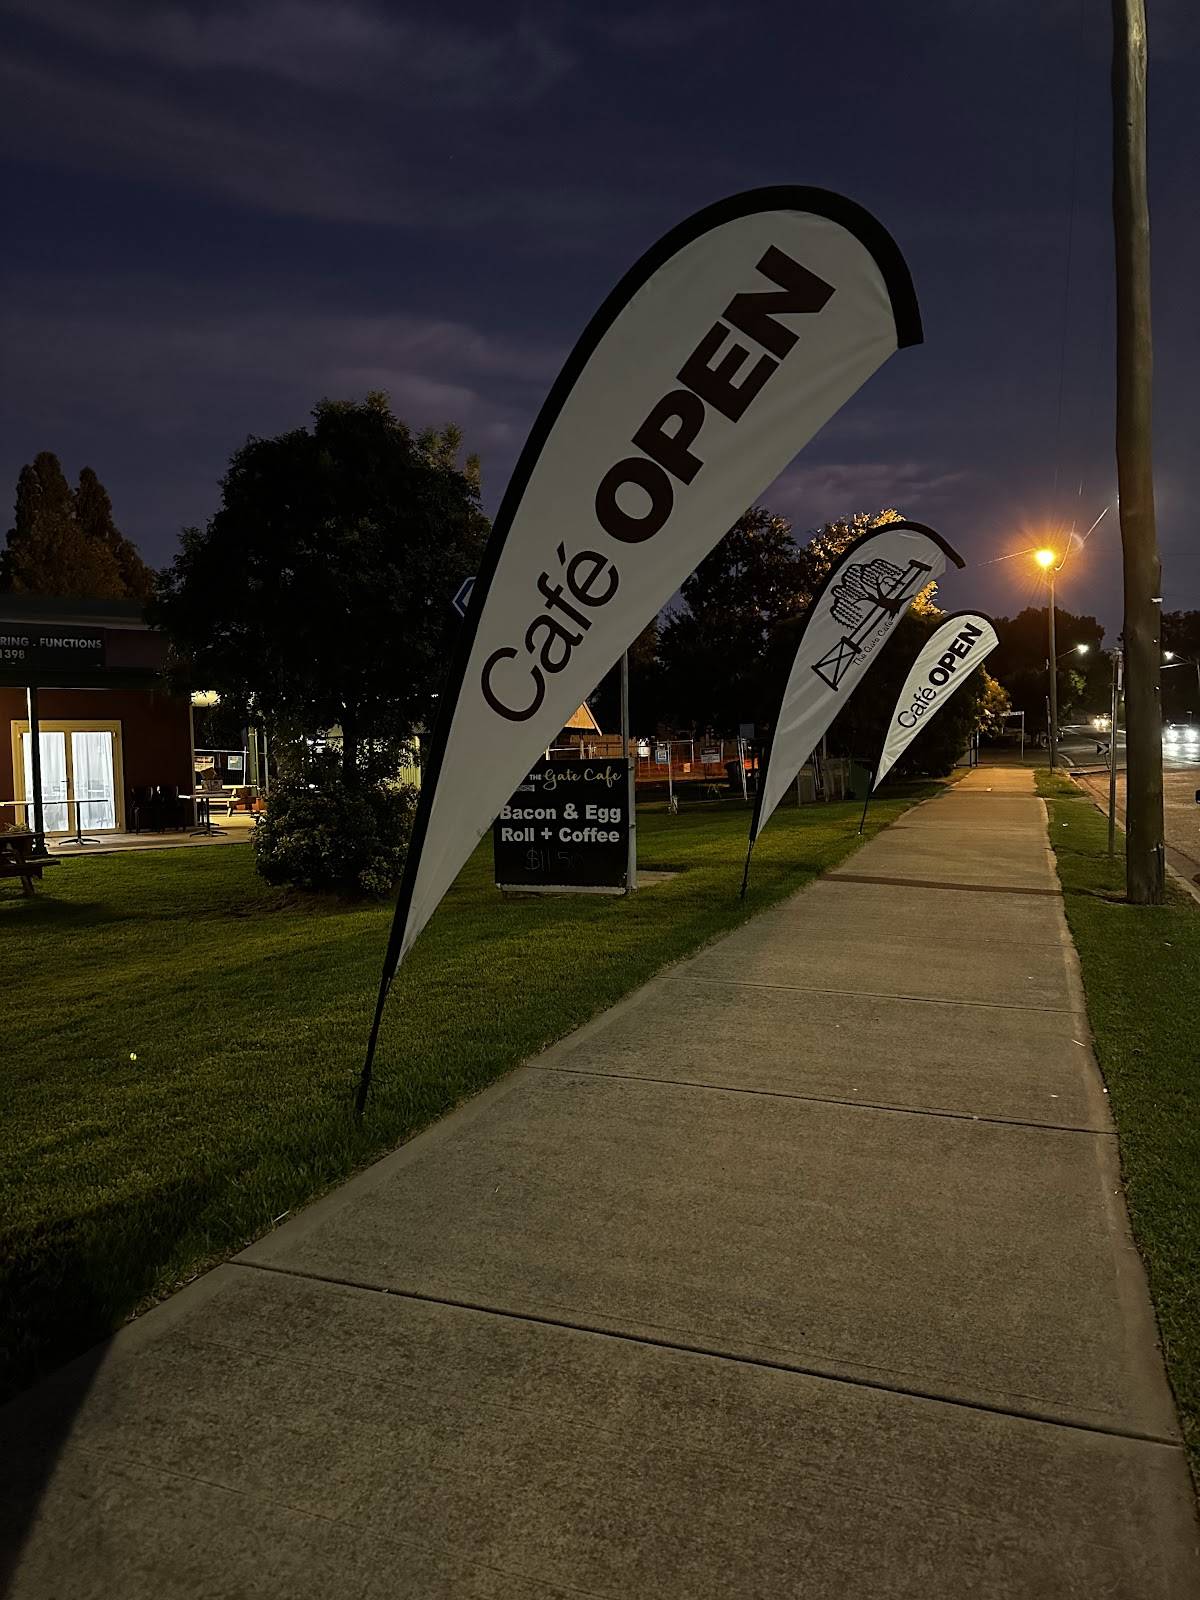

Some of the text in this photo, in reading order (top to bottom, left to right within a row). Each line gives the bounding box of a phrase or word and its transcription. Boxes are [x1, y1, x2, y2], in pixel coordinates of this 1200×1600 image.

[481, 245, 835, 721] Café OPEN
[0, 636, 30, 647] RING
[40, 637, 102, 649] FUNCTIONS
[898, 623, 983, 728] Café OPEN
[543, 769, 581, 790] Gate
[500, 803, 621, 823] Bacon & Egg
[501, 827, 620, 843] Roll + Coffee
